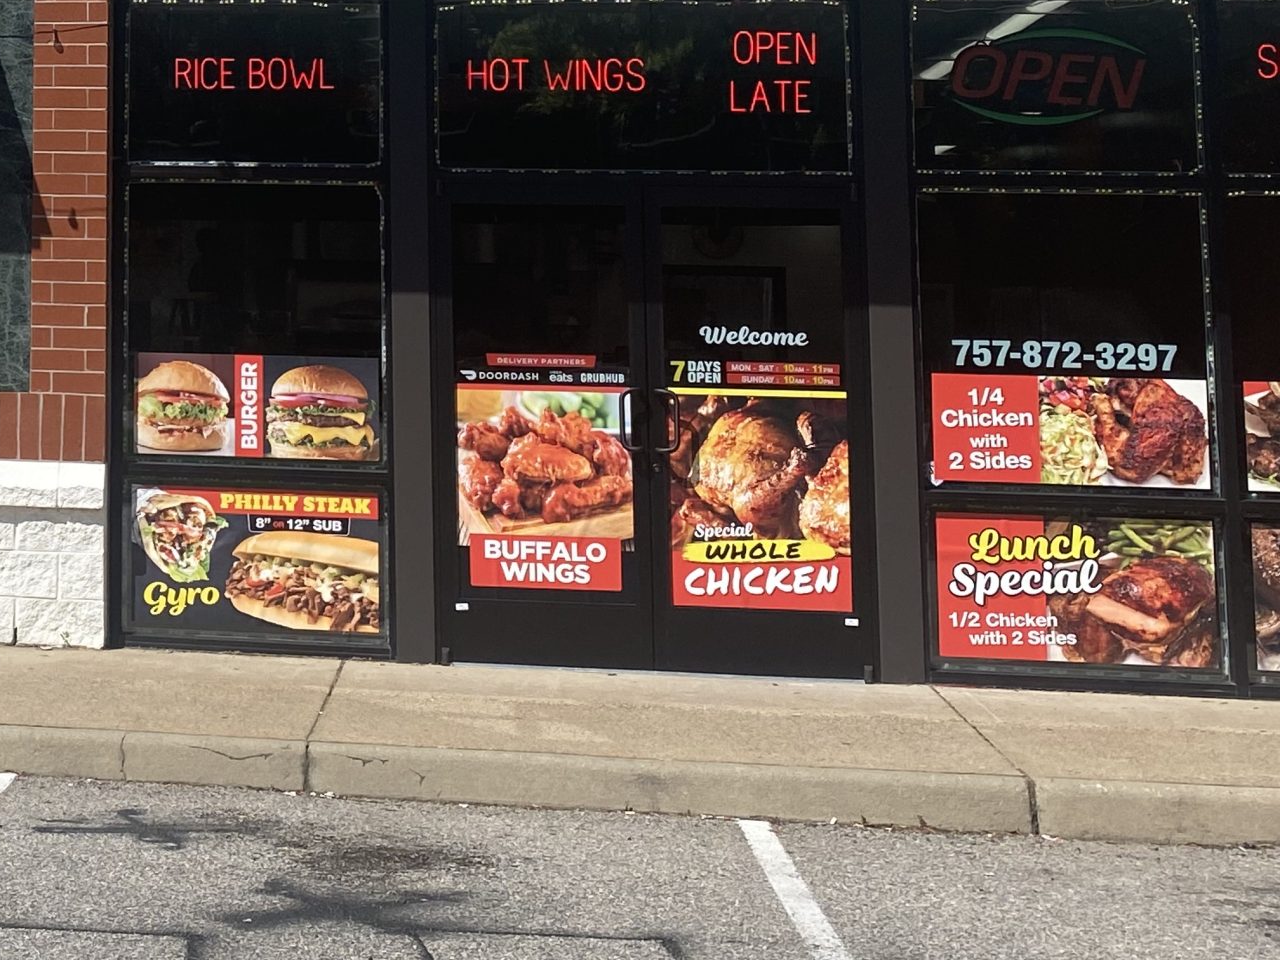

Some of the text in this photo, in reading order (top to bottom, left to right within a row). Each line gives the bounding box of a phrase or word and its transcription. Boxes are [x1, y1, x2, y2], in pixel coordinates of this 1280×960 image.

[732, 30, 818, 65] OPEN
[173, 57, 335, 90] RICE BOWL
[466, 58, 646, 92] HOT WINGS
[950, 45, 1147, 110] OPEN
[730, 79, 812, 114] LATE
[699, 326, 809, 347] Welcome
[496, 357, 587, 366] DELIVERY PARTNERS
[950, 338, 1178, 372] 757-872-3297
[478, 370, 539, 381] DOORDASH
[549, 373, 574, 383] eats
[580, 373, 625, 384] GRUBHUB
[670, 360, 721, 382] 7 DAYS
[687, 372, 722, 384] OPEN
[731, 364, 752, 372] MON
[741, 376, 775, 384] SUNDAY
[241, 362, 258, 449] BURGER
[967, 387, 1005, 407] 1/4
[940, 408, 1034, 429] Chicken
[969, 433, 1008, 449] with
[948, 451, 1033, 470] 2 Sides
[220, 493, 371, 514] PHILLY STEAK
[312, 520, 343, 531] SUB
[693, 522, 754, 542] Special
[484, 539, 607, 563] BUFFALO
[705, 541, 802, 561] WHOLE
[968, 524, 1101, 564] Lunch
[501, 561, 591, 584] WINGS
[683, 565, 840, 596] CHICKEN
[948, 559, 1103, 606] Special
[143, 581, 220, 616] Gyro
[948, 612, 1059, 628] 1/2 Chicken
[968, 631, 1078, 646] with 2 Sides
